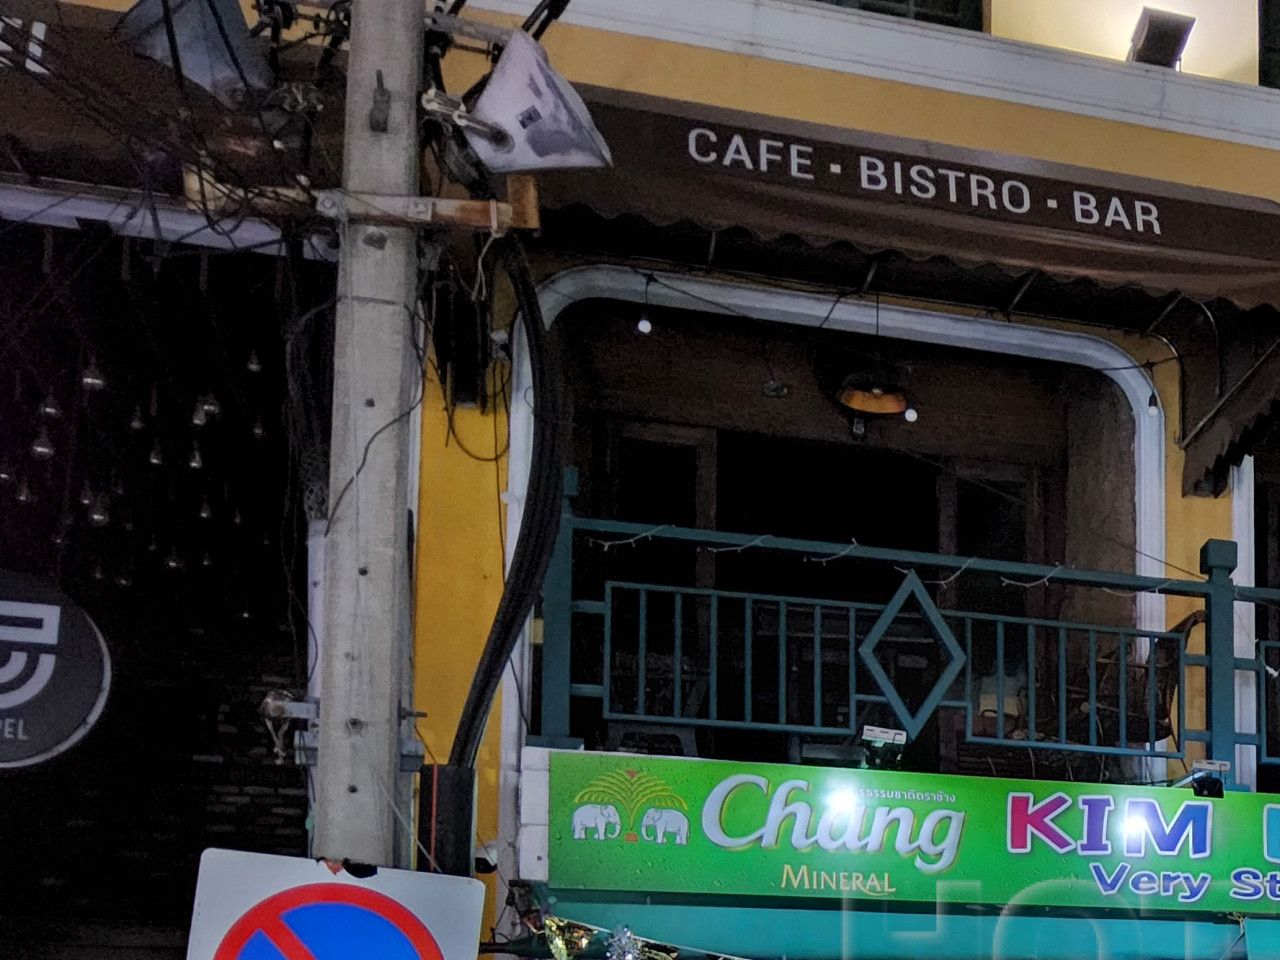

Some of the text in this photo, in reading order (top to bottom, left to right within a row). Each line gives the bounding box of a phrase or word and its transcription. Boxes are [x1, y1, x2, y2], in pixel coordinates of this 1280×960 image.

[688, 128, 1162, 236] CAFE BISTRO BAR
[702, 774, 966, 873] Chang
[1008, 791, 1213, 859] KIM
[780, 863, 897, 896] MINERAL
[1089, 861, 1212, 903] Very
